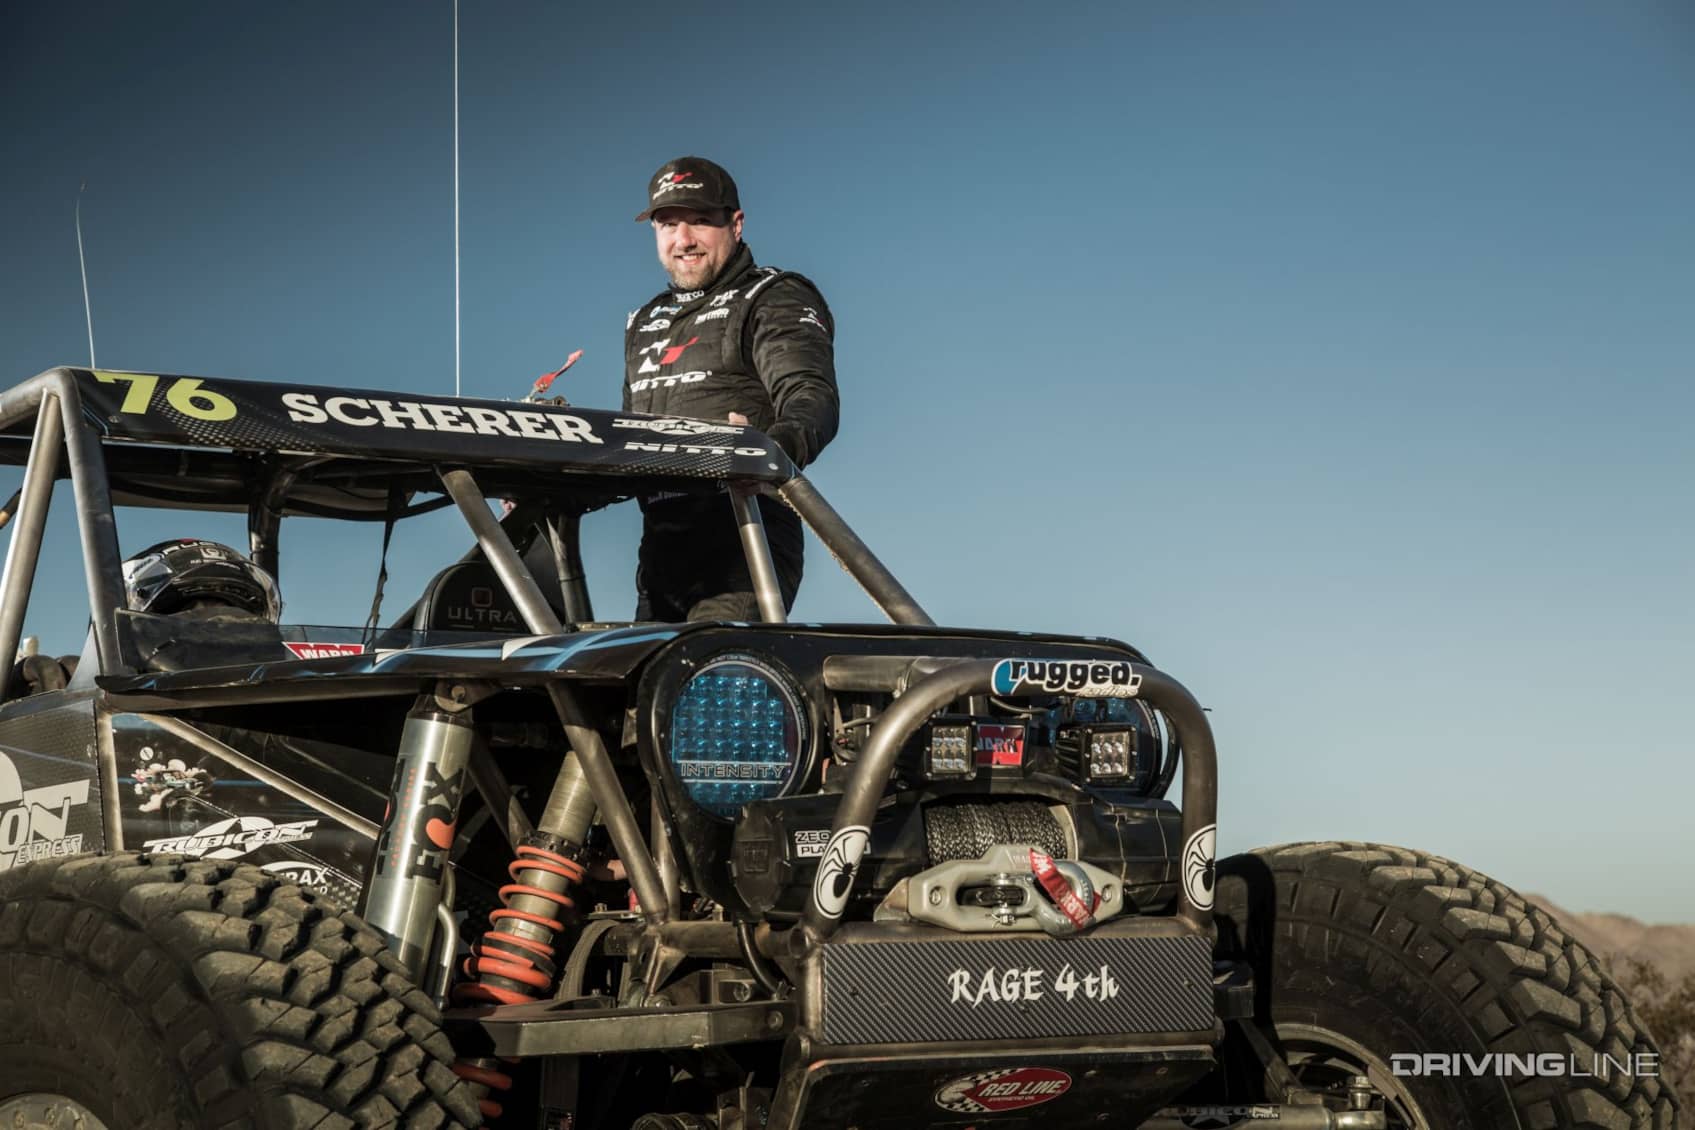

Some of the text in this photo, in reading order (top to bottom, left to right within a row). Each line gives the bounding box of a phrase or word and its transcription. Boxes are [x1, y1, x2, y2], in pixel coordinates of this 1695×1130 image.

[91, 371, 237, 421] 76
[282, 393, 604, 444] SCHERER
[624, 441, 767, 457] NITTO
[448, 607, 517, 623] ULTRA
[680, 763, 785, 778] INTENSITY
[404, 762, 467, 885] FOX
[18, 836, 82, 863] EXPRESS
[947, 963, 1120, 1009] RAGE 4th
[978, 1080, 1067, 1097] RED LINE
